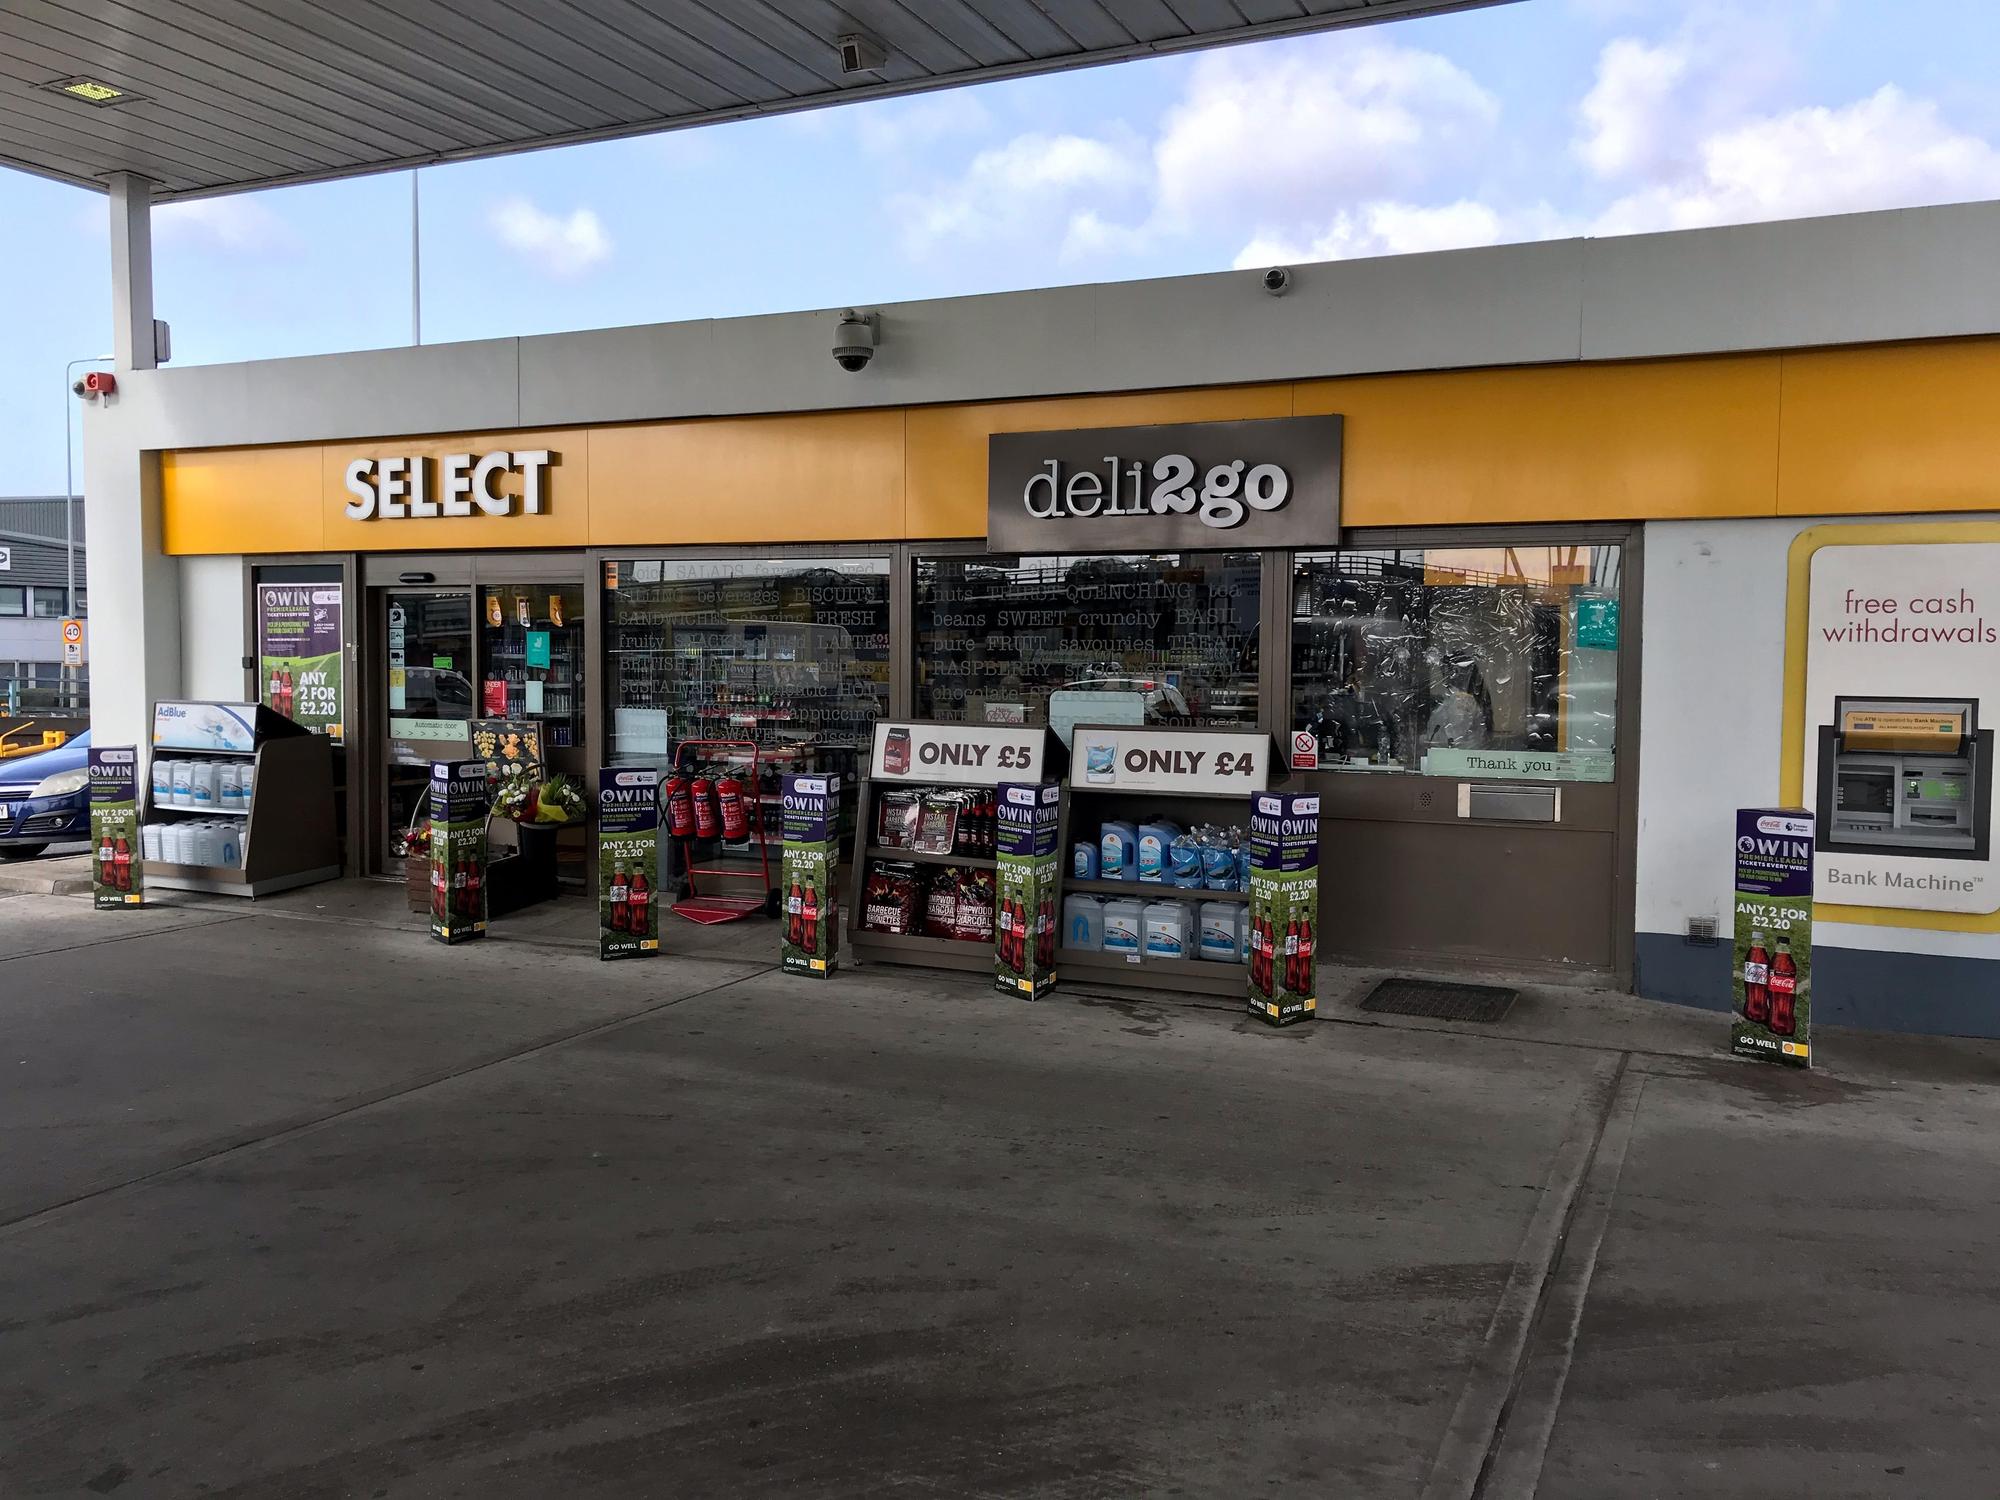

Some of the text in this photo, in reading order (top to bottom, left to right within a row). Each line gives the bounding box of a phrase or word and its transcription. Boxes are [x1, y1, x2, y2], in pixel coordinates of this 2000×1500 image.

[344, 450, 549, 520] SELECT
[1024, 454, 1288, 528] deli2go
[676, 564, 744, 579] SALADS
[278, 592, 310, 606] WIN
[698, 590, 780, 605] beverages
[793, 587, 875, 602] BISCUITS
[933, 586, 973, 602] nuts
[1209, 583, 1241, 598] tea
[1845, 588, 1974, 614] free cash
[619, 611, 876, 625] SANDWICHES FRESH
[933, 608, 1242, 629] beans SWEET crunchy BASIL
[66, 628, 78, 636] 40
[1822, 618, 1997, 643] withdrawals
[620, 632, 665, 649] fruity
[817, 635, 875, 650] LATTE
[933, 635, 1242, 655] pure FRUIT savouries TREAT
[620, 657, 684, 671] BRITISH
[933, 660, 1050, 676] RASPBERRY
[300, 671, 327, 686] ANY
[300, 686, 336, 700] 2 FOR
[838, 682, 877, 697] HOT
[933, 685, 1023, 700] chocolate
[158, 706, 187, 718] AdBlue
[300, 702, 336, 716] £2.20
[781, 705, 876, 724] cappuccino
[725, 726, 785, 742] WATER
[919, 742, 1031, 769] ONLY £5
[1124, 748, 1254, 777] ONLY £4
[100, 766, 132, 776] WIN
[1467, 756, 1517, 770] Thank
[1522, 758, 1553, 773] you
[459, 781, 484, 794] WIN
[616, 789, 655, 802] WIN
[794, 796, 824, 812] WIN
[924, 812, 948, 821] INSTANT
[1007, 806, 1032, 823] WIN
[1042, 806, 1058, 822] WIN
[1258, 818, 1279, 836] WIN
[1292, 818, 1318, 834] WIN
[450, 832, 464, 840] ANY
[472, 828, 484, 836] FOR
[458, 836, 477, 846] £2.20
[602, 840, 656, 850] ANY 2 FOR
[1757, 838, 1808, 859] WIN
[614, 849, 644, 858] £2.20
[784, 850, 824, 860] ANY 2 FOR
[1738, 854, 1808, 866] PREMIER LEAGUE
[792, 860, 814, 869] £2.20
[996, 861, 1032, 876] ANY 2 FOR
[1766, 862, 1788, 870] EVERY
[1004, 872, 1023, 884] £2.20
[1250, 876, 1278, 892] ANY 2 FOR
[1828, 868, 1877, 886] Bank
[1281, 878, 1317, 892] ANY 2 FOR
[1256, 888, 1272, 900] £2.20
[1290, 890, 1310, 900] £2.20
[868, 904, 901, 915] BARBECUE
[957, 906, 992, 915] LUMPWOOD
[1736, 902, 1808, 920] ANY 2 FOR
[867, 914, 900, 925] BRIQUETTES
[956, 914, 992, 926] CHARCOAL
[1752, 916, 1790, 930] £2.20
[1770, 976, 1794, 988] Coca-Cola
[1250, 997, 1266, 1010] GO WELL
[1282, 1004, 1302, 1014] GO WELL
[1740, 1036, 1777, 1049] GO WELL
